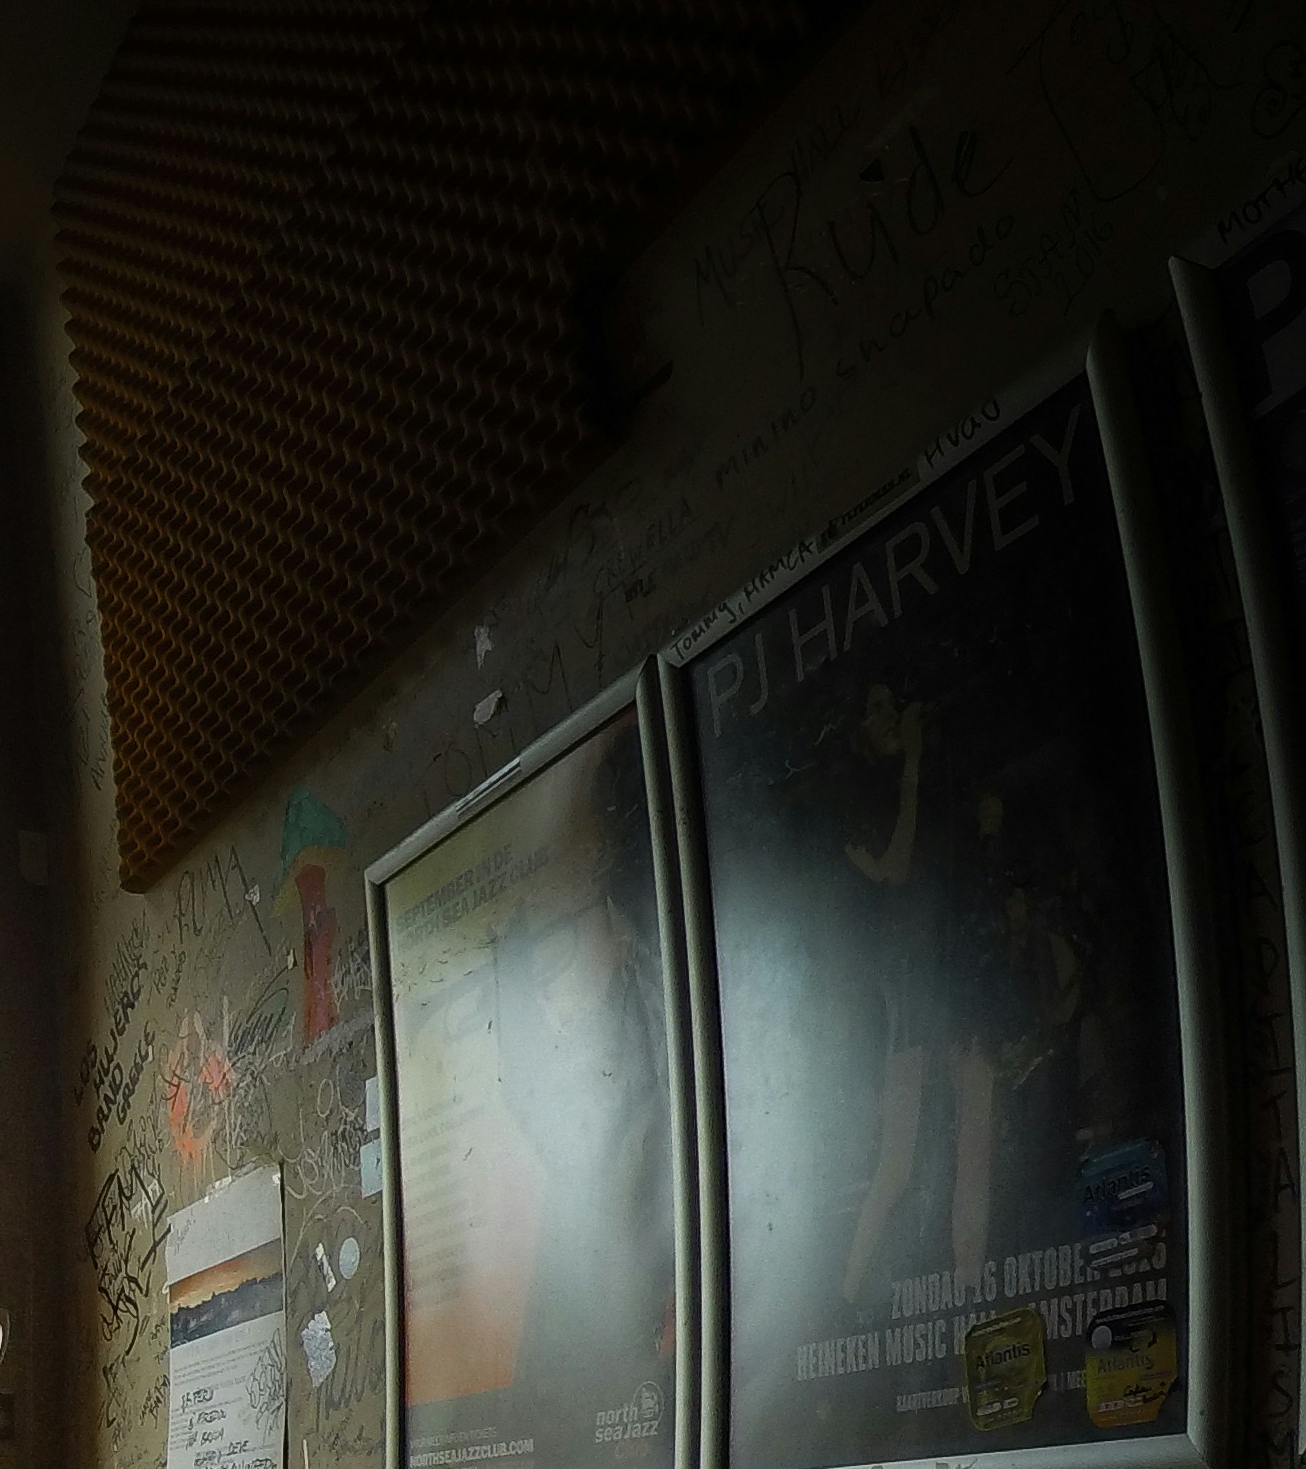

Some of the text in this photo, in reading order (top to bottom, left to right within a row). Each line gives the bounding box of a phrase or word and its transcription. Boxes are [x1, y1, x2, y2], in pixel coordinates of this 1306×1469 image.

[706, 404, 1083, 738] PJ HARVEY
[795, 1332, 881, 1382] HEINEKEN
[886, 1318, 947, 1367] MUSIC
[1028, 1278, 1168, 1341] MSTERDAM
[975, 1341, 1031, 1370] Atlantis
[1096, 1352, 1155, 1376] Atlantis
[595, 1404, 638, 1426] north
